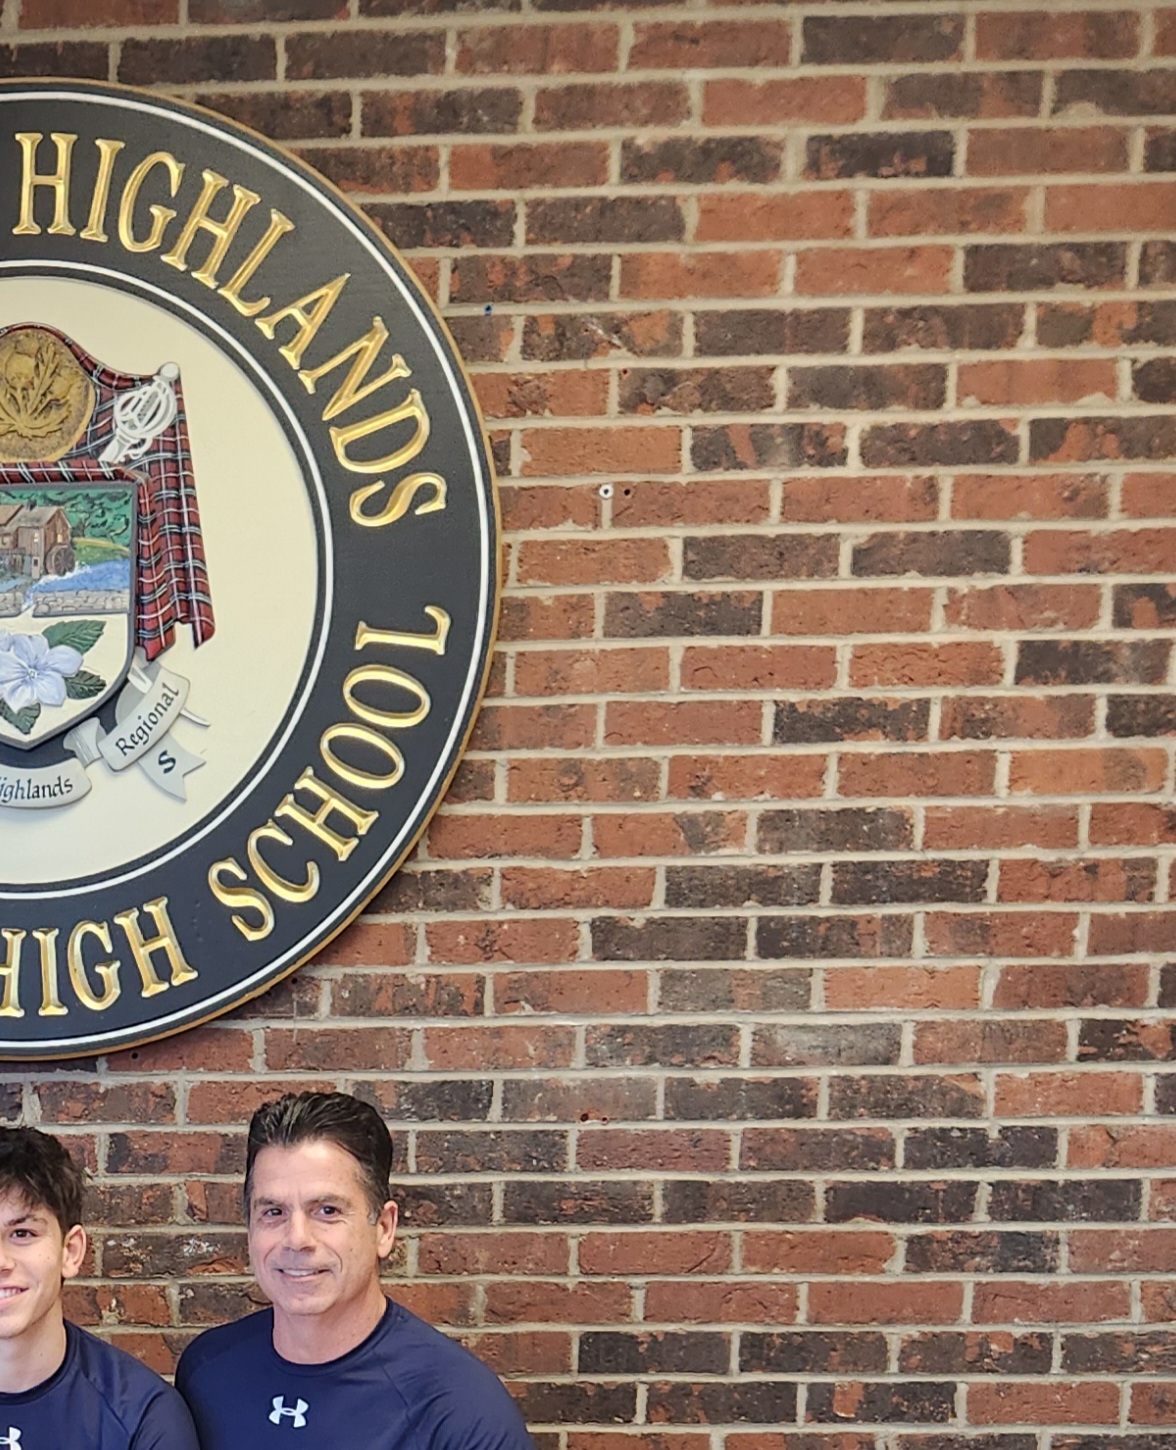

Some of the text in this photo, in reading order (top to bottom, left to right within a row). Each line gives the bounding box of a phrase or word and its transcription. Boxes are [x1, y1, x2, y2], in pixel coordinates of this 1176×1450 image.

[12, 132, 448, 533] HIGHLANDS
[114, 681, 180, 757] Regional
[157, 749, 178, 774] S
[207, 605, 452, 943] SCHOOL
